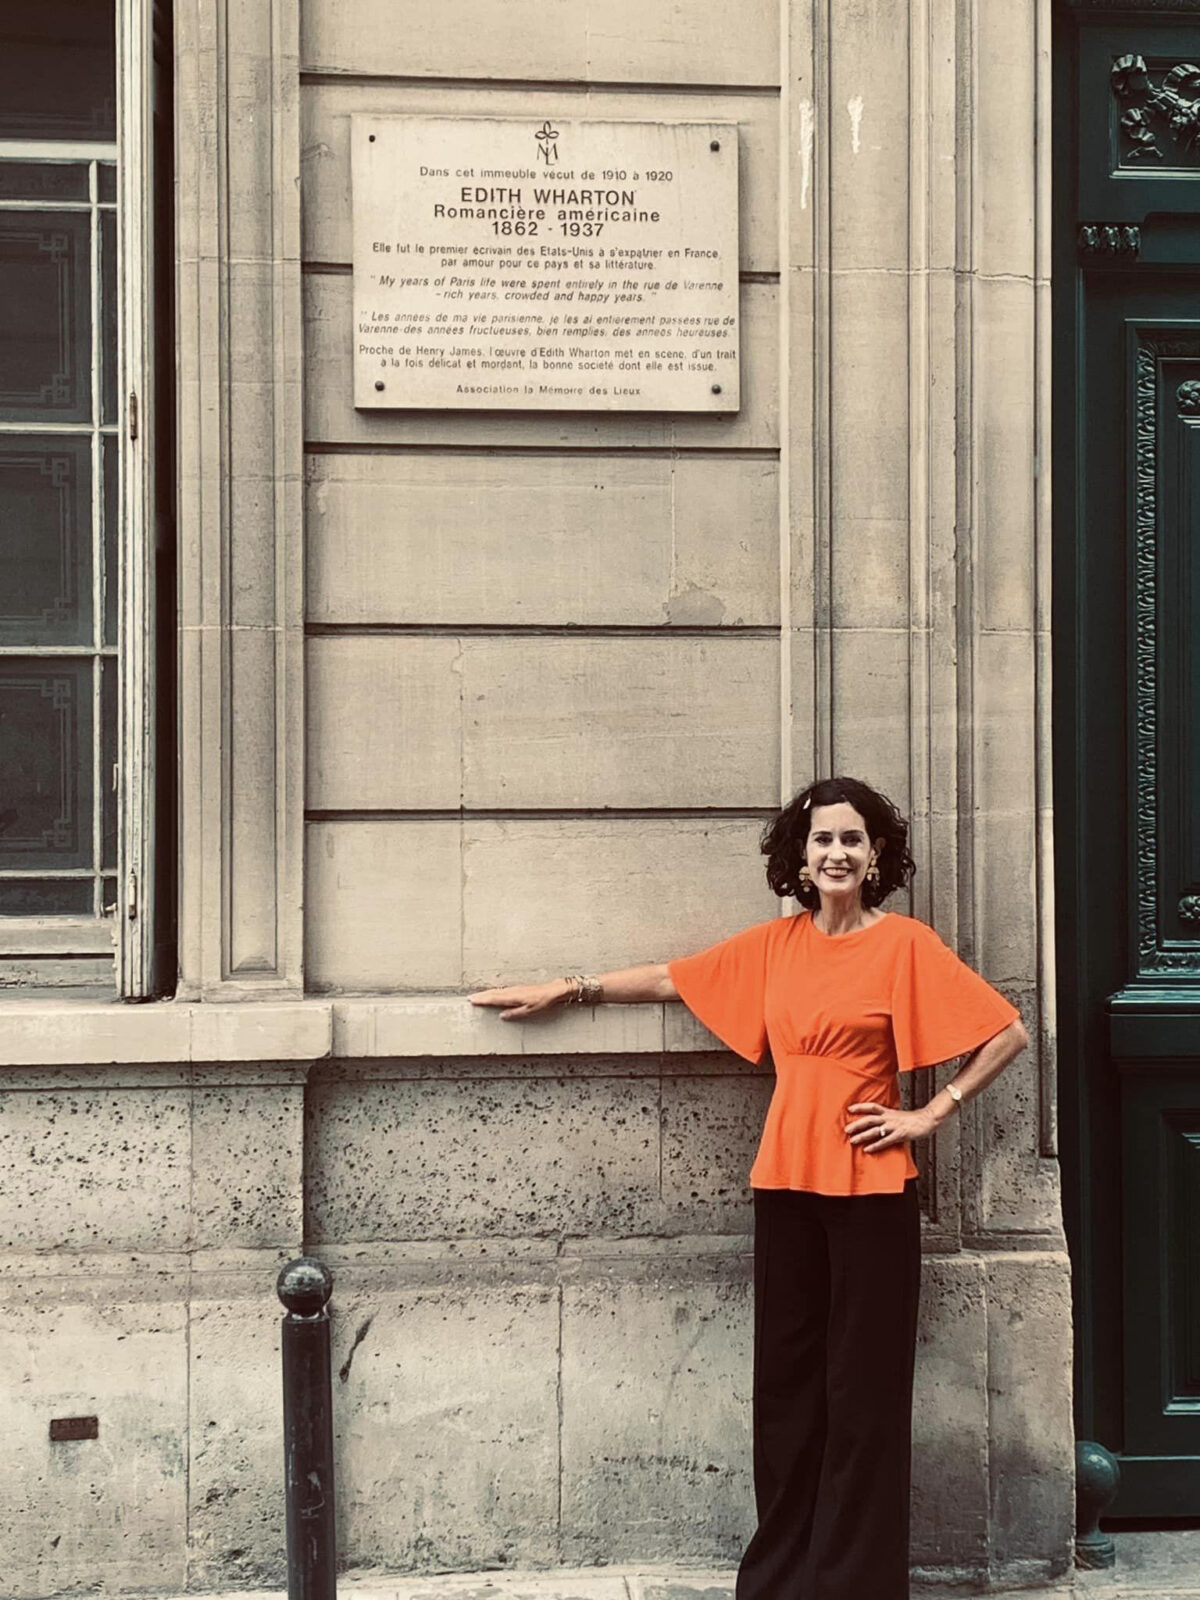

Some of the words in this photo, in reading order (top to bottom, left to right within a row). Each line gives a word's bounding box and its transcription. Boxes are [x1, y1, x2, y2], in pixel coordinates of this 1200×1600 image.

[420, 167, 449, 177] Dans
[456, 168, 475, 177] cet
[481, 168, 537, 179] immeuble
[543, 171, 574, 180] vécut
[581, 171, 595, 180] de
[602, 171, 627, 180] 1910
[646, 171, 673, 181] 1920
[461, 187, 522, 203] EDITH
[534, 189, 635, 206] WHARTON
[434, 204, 546, 220] Romancière
[558, 209, 660, 222] américaine
[492, 222, 538, 236] 1862
[560, 223, 604, 237] 1937
[372, 242, 391, 253] Elle
[397, 243, 410, 253] fut
[416, 244, 425, 254] le
[429, 245, 468, 256] premier
[517, 246, 535, 256] des
[441, 258, 457, 268] par
[462, 259, 494, 267] amour
[499, 260, 522, 269] pour
[527, 260, 539, 268] ce
[545, 261, 569, 270] pays
[574, 260, 584, 269] et
[589, 261, 601, 269] sa
[379, 276, 396, 287] My
[400, 278, 429, 287] years
[434, 277, 445, 287] of
[450, 277, 476, 287] Paris
[480, 278, 496, 287] life
[502, 279, 527, 288] were
[531, 280, 561, 290] spent
[565, 279, 604, 291] entirely
[608, 280, 617, 288] in
[622, 281, 638, 289] the
[643, 281, 660, 290] rue
[665, 281, 678, 290] de
[683, 280, 724, 291] Varenne
[444, 290, 463, 299] rich
[505, 291, 550, 301] crowded
[554, 292, 573, 301] and
[578, 293, 610, 304] happy
[372, 312, 390, 322] Les
[436, 313, 448, 322] de
[453, 314, 468, 322] ma
[473, 313, 487, 323] vie
[549, 315, 559, 325] je
[564, 314, 578, 324] les
[583, 315, 593, 325] ai
[704, 317, 719, 325] rue
[723, 316, 735, 325] de
[537, 327, 558, 336] bien
[612, 327, 631, 337] des
[359, 345, 393, 355] Proche
[399, 346, 412, 355] de
[416, 346, 445, 358] Henry
[569, 347, 610, 358] Wharton
[615, 349, 634, 358] met
[692, 349, 712, 359] d'un
[716, 350, 736, 359] trait
[392, 358, 400, 367] la
[405, 358, 423, 368] fois
[467, 359, 476, 368] et
[481, 359, 525, 370] mordant,
[530, 359, 538, 369] la
[543, 360, 573, 370] bonne
[619, 361, 641, 370] dont
[646, 361, 663, 371] elle
[667, 361, 683, 371] est
[456, 384, 519, 394] Association
[524, 386, 533, 394] la
[589, 387, 608, 395] des
[613, 386, 641, 395] Lieux
